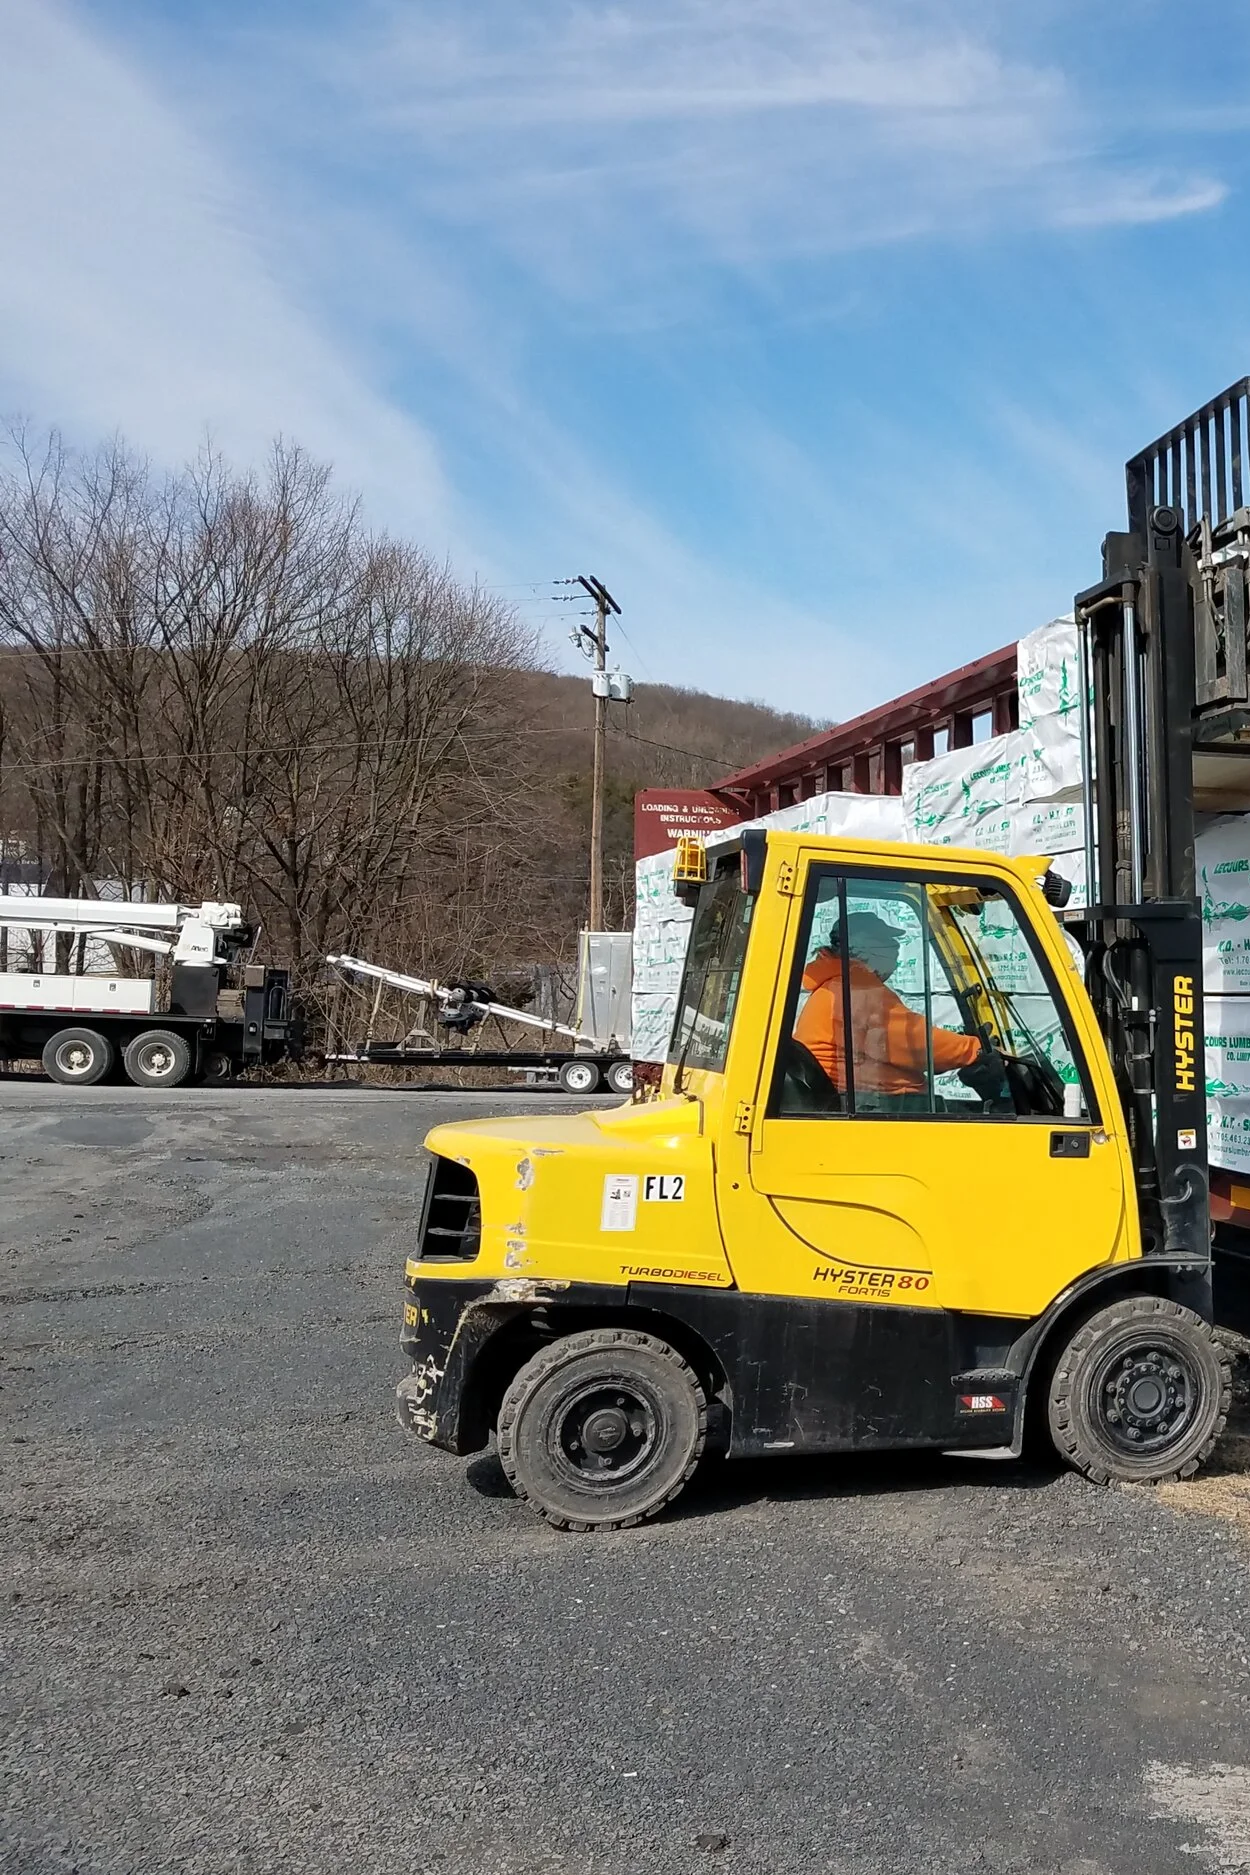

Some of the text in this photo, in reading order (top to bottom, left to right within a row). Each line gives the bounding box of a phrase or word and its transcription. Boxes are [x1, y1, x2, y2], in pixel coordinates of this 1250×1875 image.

[641, 803, 679, 813] LOADING
[1214, 859, 1249, 874] LECOURS
[1173, 975, 1195, 1091] HYSTER
[1226, 1051, 1235, 1061] CO.
[645, 1176, 684, 1200] FL2
[619, 1265, 726, 1282] TURBODIESEL
[813, 1267, 930, 1291] HYSTER 80
[838, 1285, 891, 1298] FORTIS
[971, 1395, 993, 1408] HSS
